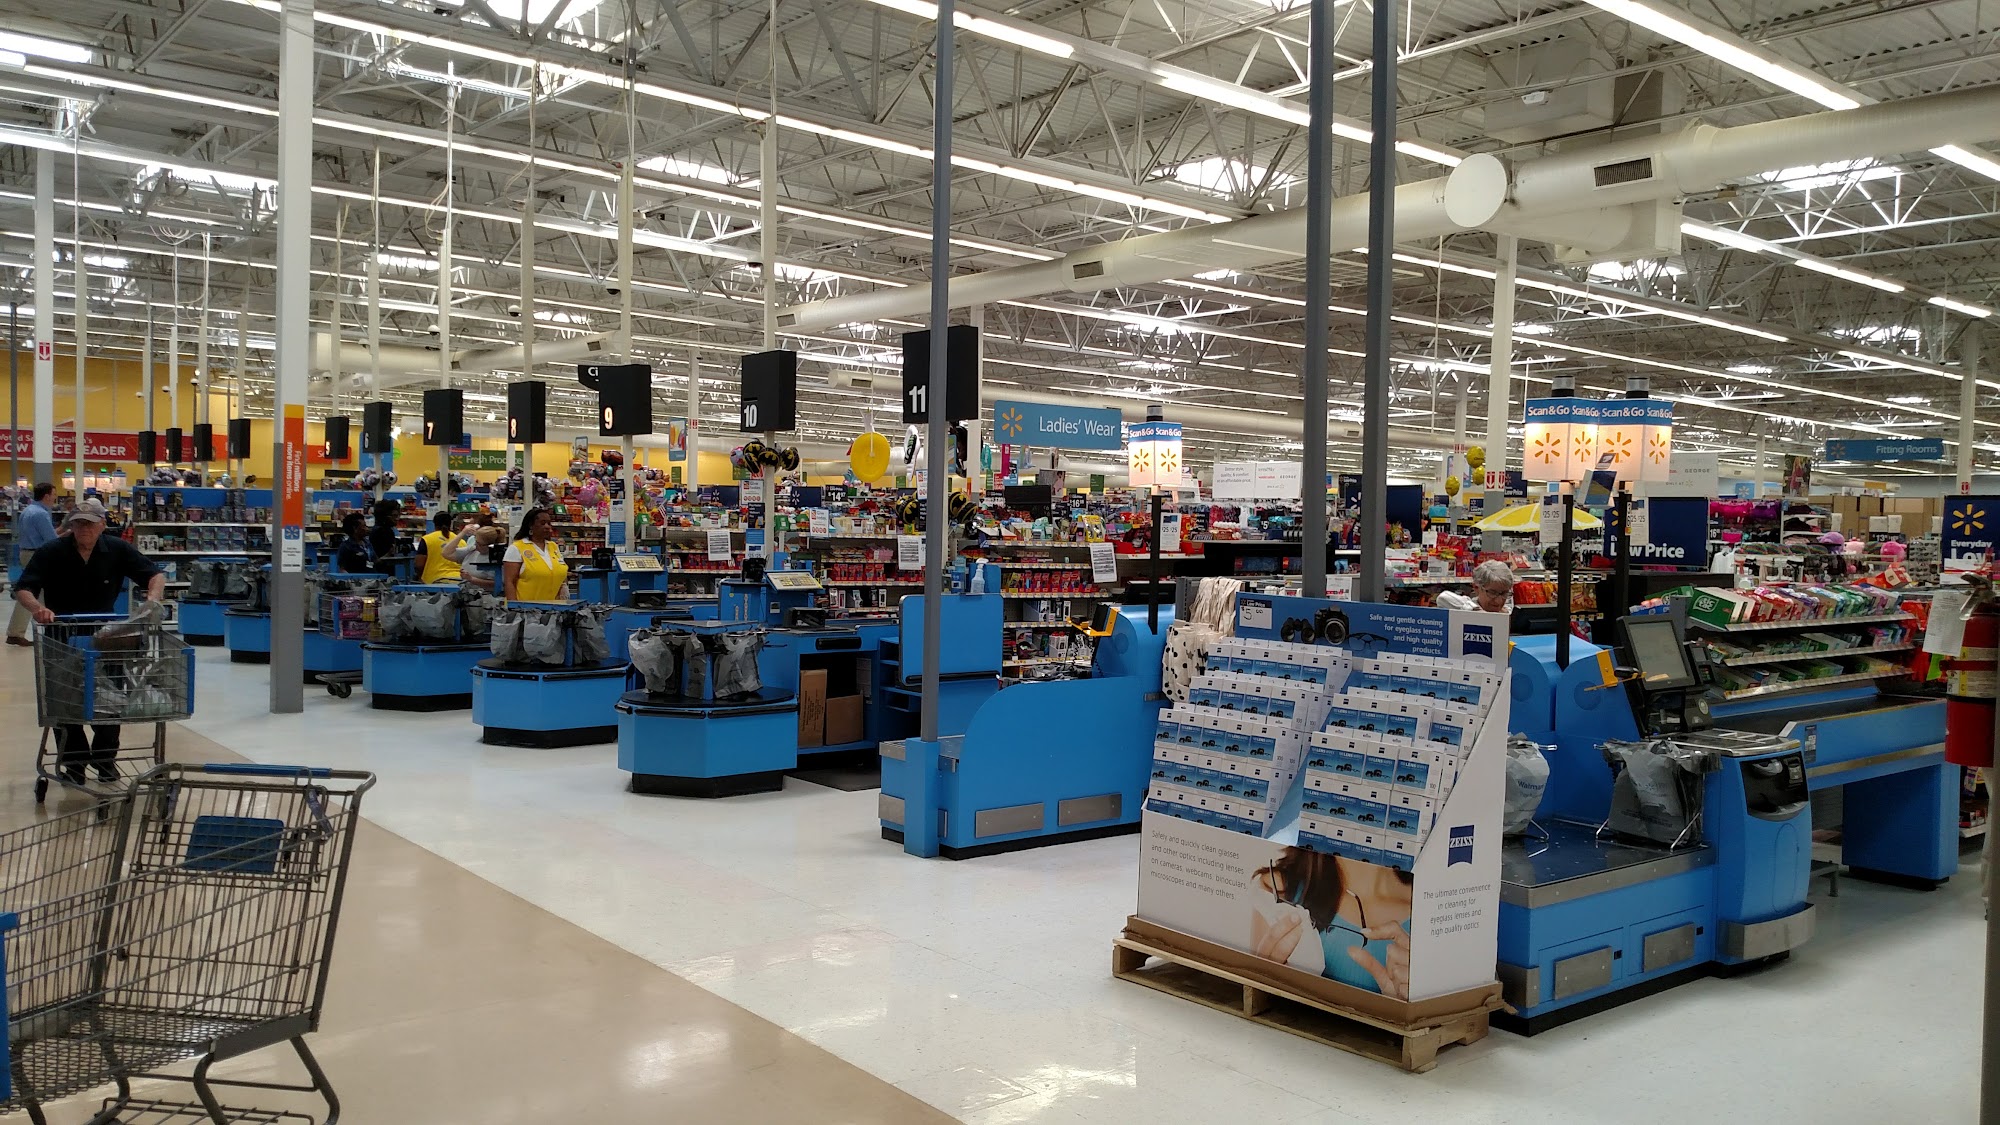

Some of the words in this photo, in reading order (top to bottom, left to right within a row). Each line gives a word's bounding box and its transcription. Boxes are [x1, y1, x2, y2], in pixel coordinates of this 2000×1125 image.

[909, 385, 926, 413] 11
[744, 404, 758, 427] 10
[1528, 404, 1570, 416] Scan&Go
[1572, 405, 1599, 417] Scan&Go
[1602, 406, 1645, 418] Scan&Go
[1646, 407, 1673, 418] Scan&Go
[604, 407, 613, 429] 9
[427, 421, 434, 440] 7
[511, 418, 517, 438] 8
[1084, 420, 1116, 437] Wear
[1129, 429, 1154, 438] Scan&Go
[1155, 428, 1182, 438] Scan&Go
[364, 432, 370, 449] 6
[84, 446, 126, 456] EADER
[325, 441, 331, 455] 5
[1876, 445, 1904, 455] Fitting
[1906, 445, 1938, 454] Rooms
[466, 455, 488, 465] Fresh
[1610, 545, 1642, 558] Lw
[1649, 543, 1685, 558] Price
[1951, 540, 1992, 549] Everyday
[1369, 614, 1383, 622] Safe
[1396, 616, 1416, 626] gentle
[1416, 617, 1444, 628] cleaning
[1384, 624, 1394, 632] for
[1394, 626, 1422, 635] eyeglass
[1423, 627, 1444, 636] lenses
[1393, 634, 1405, 642] and
[1406, 636, 1420, 644] high
[1421, 637, 1443, 646] quality
[1463, 632, 1492, 644] ZEISS
[1412, 645, 1442, 655] products.
[1152, 830, 1168, 842] Safely
[1168, 835, 1180, 844] and
[1180, 838, 1200, 849] quickly
[1201, 844, 1216, 854] clean
[1218, 848, 1240, 860] glasses
[1450, 836, 1474, 848] ZEISS
[1150, 857, 1158, 865] on
[1152, 844, 1162, 853] and
[1163, 847, 1178, 857] other
[1179, 851, 1196, 862] optics
[1197, 856, 1224, 872] including
[1226, 863, 1244, 875] lenses
[1150, 870, 1184, 886] microscopes
[1186, 880, 1196, 889] and
[1198, 884, 1214, 896] many
[1424, 892, 1434, 900] The
[1434, 888, 1458, 898] ultimate
[1458, 884, 1491, 895] convenience
[1444, 899, 1467, 910] cleaning
[1468, 897, 1476, 905] for
[1430, 914, 1453, 926] eyeglass
[1454, 912, 1470, 921] lenses
[1472, 908, 1482, 916] and
[1430, 927, 1444, 938] high
[1444, 924, 1462, 936] quality
[1464, 921, 1480, 930] optics
